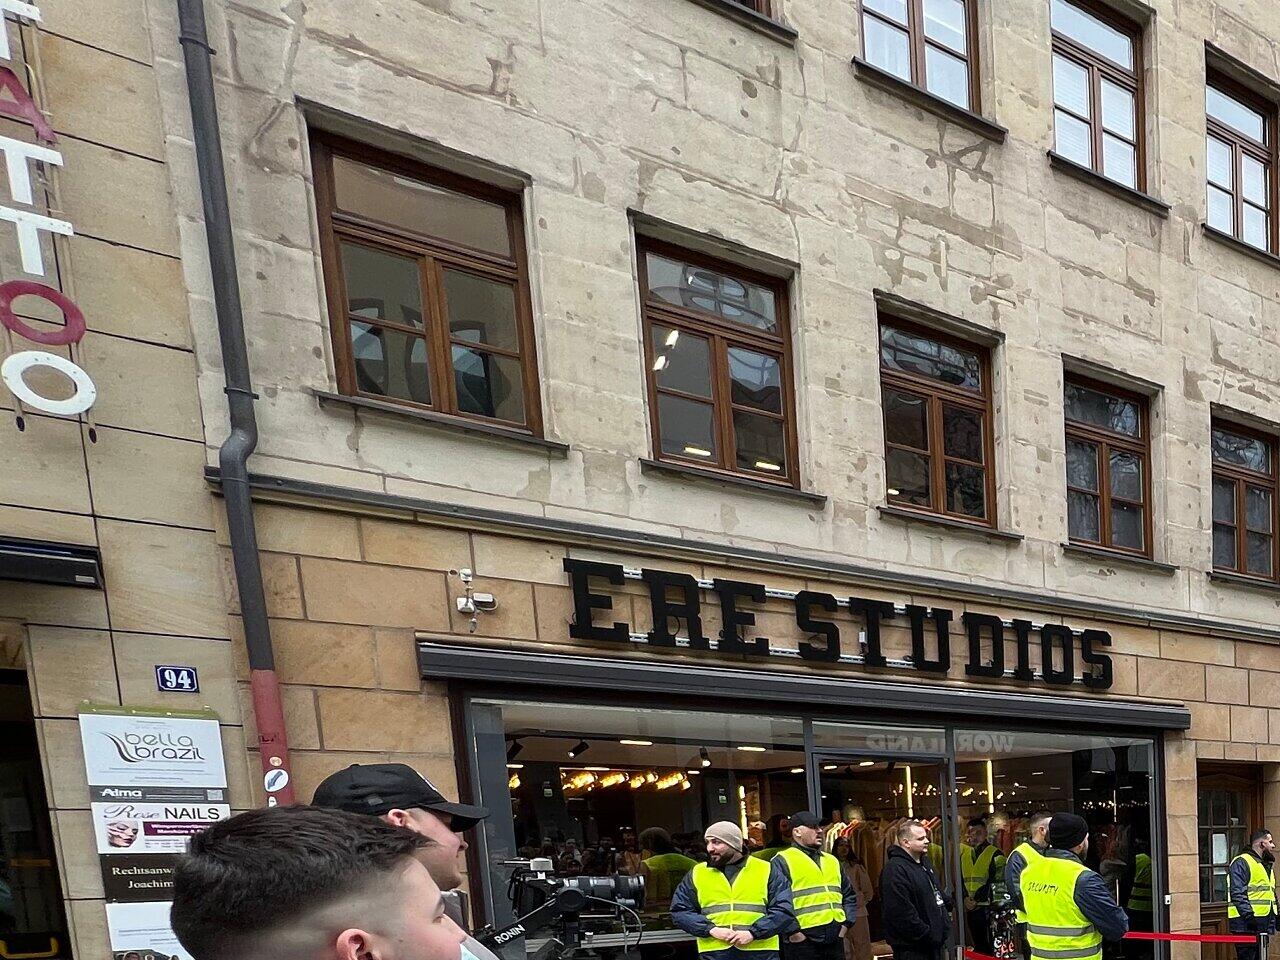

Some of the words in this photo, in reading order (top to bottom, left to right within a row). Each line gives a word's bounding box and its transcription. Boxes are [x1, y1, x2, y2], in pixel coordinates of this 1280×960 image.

[795, 590, 1114, 690] STUDIOS
[163, 669, 192, 690] 94
[124, 731, 194, 748] bella
[134, 745, 206, 761] brazil
[103, 804, 160, 819] Rose
[164, 807, 220, 820] NAILS
[112, 866, 175, 876] Rechtsanw
[128, 880, 174, 889] Joachim
[1027, 881, 1059, 896] SECURITY
[494, 924, 526, 944] RONIN
